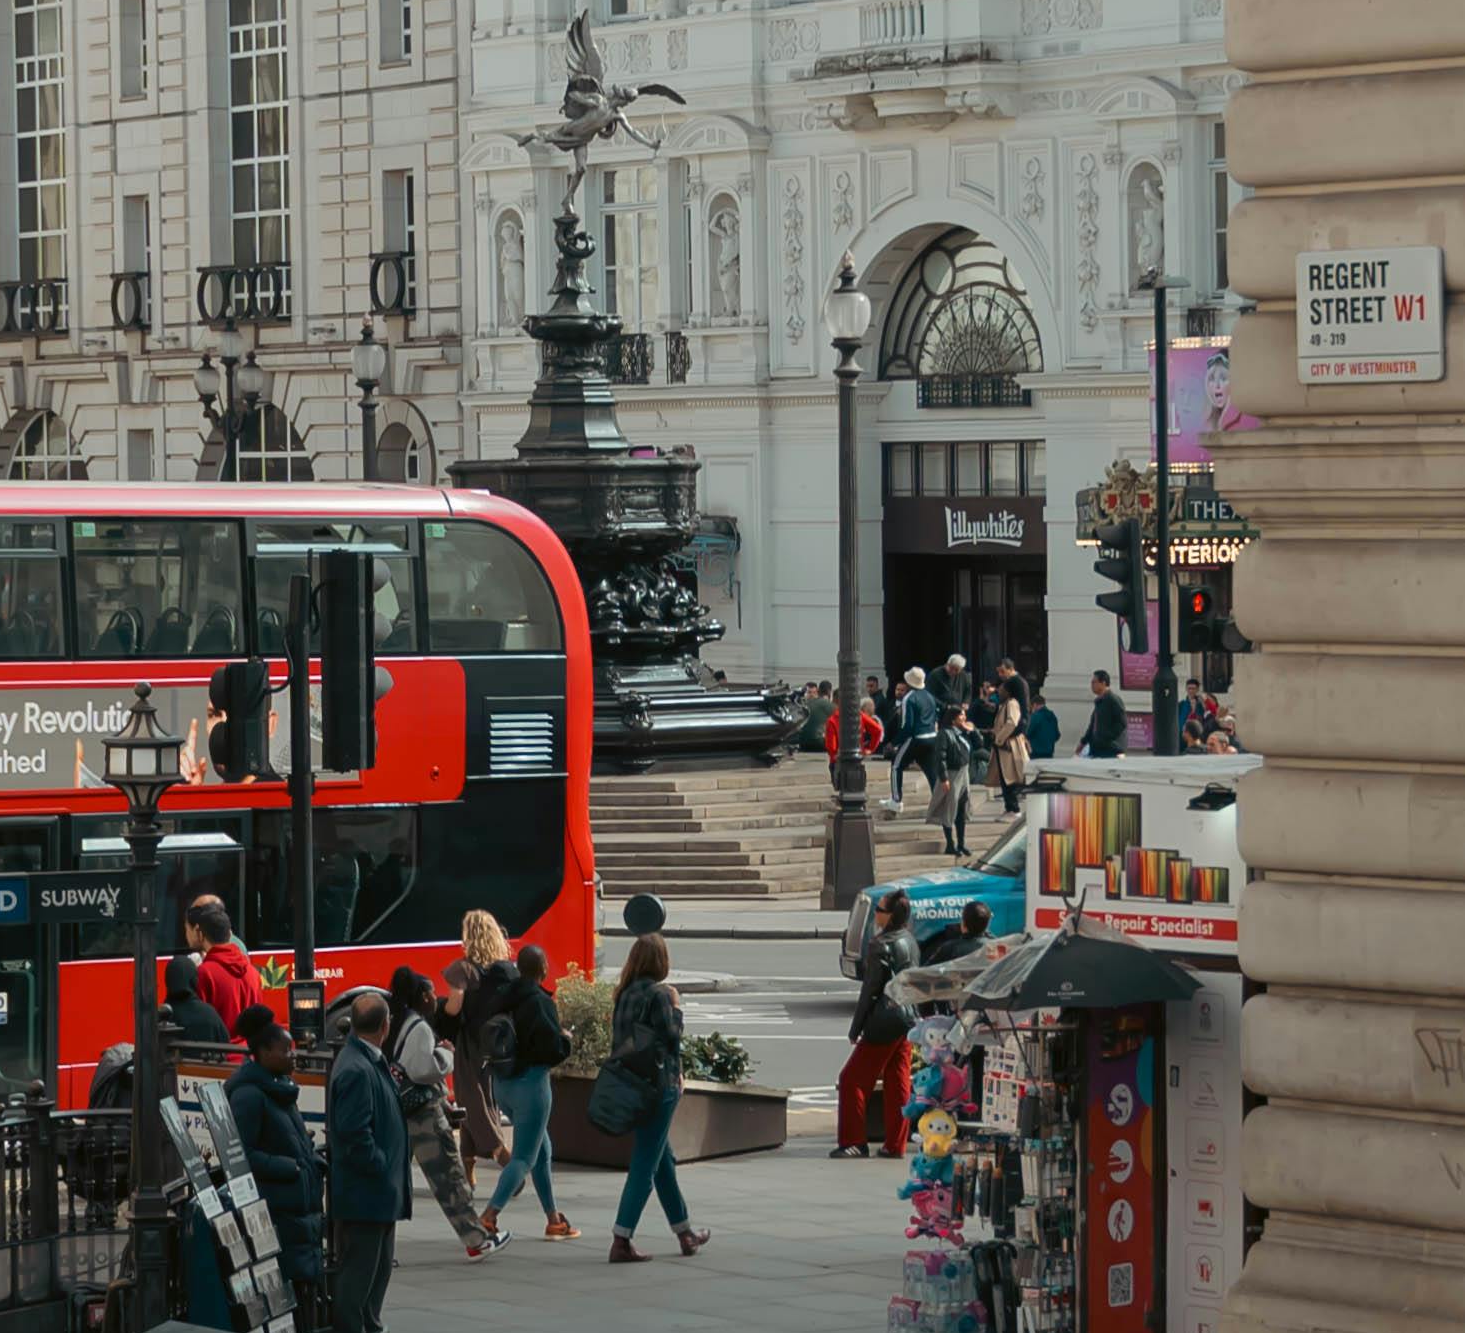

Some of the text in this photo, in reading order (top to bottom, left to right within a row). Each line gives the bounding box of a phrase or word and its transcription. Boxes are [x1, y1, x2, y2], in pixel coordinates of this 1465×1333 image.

[1308, 260, 1390, 292] REGENT
[1309, 294, 1426, 326] STREET W1
[1309, 333, 1321, 347] 49
[1329, 332, 1346, 346] 319
[1310, 360, 1417, 377] CITY OF WESTMINSTER
[1189, 500, 1236, 520] THE
[944, 506, 1025, 548] Lillywhites
[1145, 544, 1240, 566] CITERION
[40, 886, 121, 909] SUBWAY
[916, 907, 964, 920] MOMEN
[1104, 913, 1148, 935] Repair
[1150, 916, 1215, 936] Specialist
